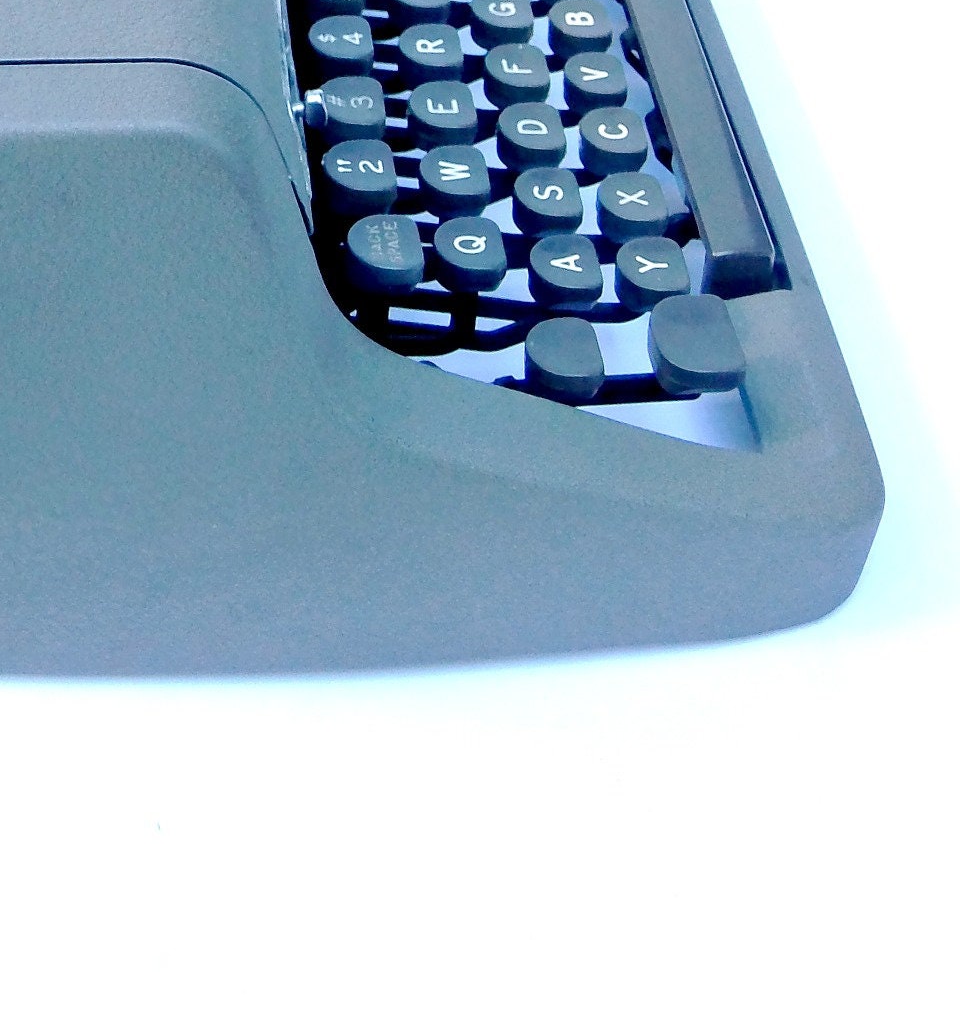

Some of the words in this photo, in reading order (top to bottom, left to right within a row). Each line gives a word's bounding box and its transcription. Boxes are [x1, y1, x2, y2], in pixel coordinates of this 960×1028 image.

[489, 2, 516, 16] G
[565, 12, 594, 25] B
[318, 34, 336, 43] $
[343, 33, 363, 44] 4
[416, 39, 445, 53] R
[502, 59, 532, 73] F
[580, 67, 608, 81] V
[350, 96, 373, 108] 3
[427, 98, 459, 113] E
[517, 120, 548, 134] D
[598, 124, 628, 139] C
[359, 160, 383, 173] 2
[438, 161, 470, 180] W
[533, 186, 563, 200] S
[617, 190, 648, 205] X
[383, 221, 401, 262] SPACE
[453, 236, 486, 254] Q
[550, 255, 582, 271] A
[638, 256, 668, 273] Y
